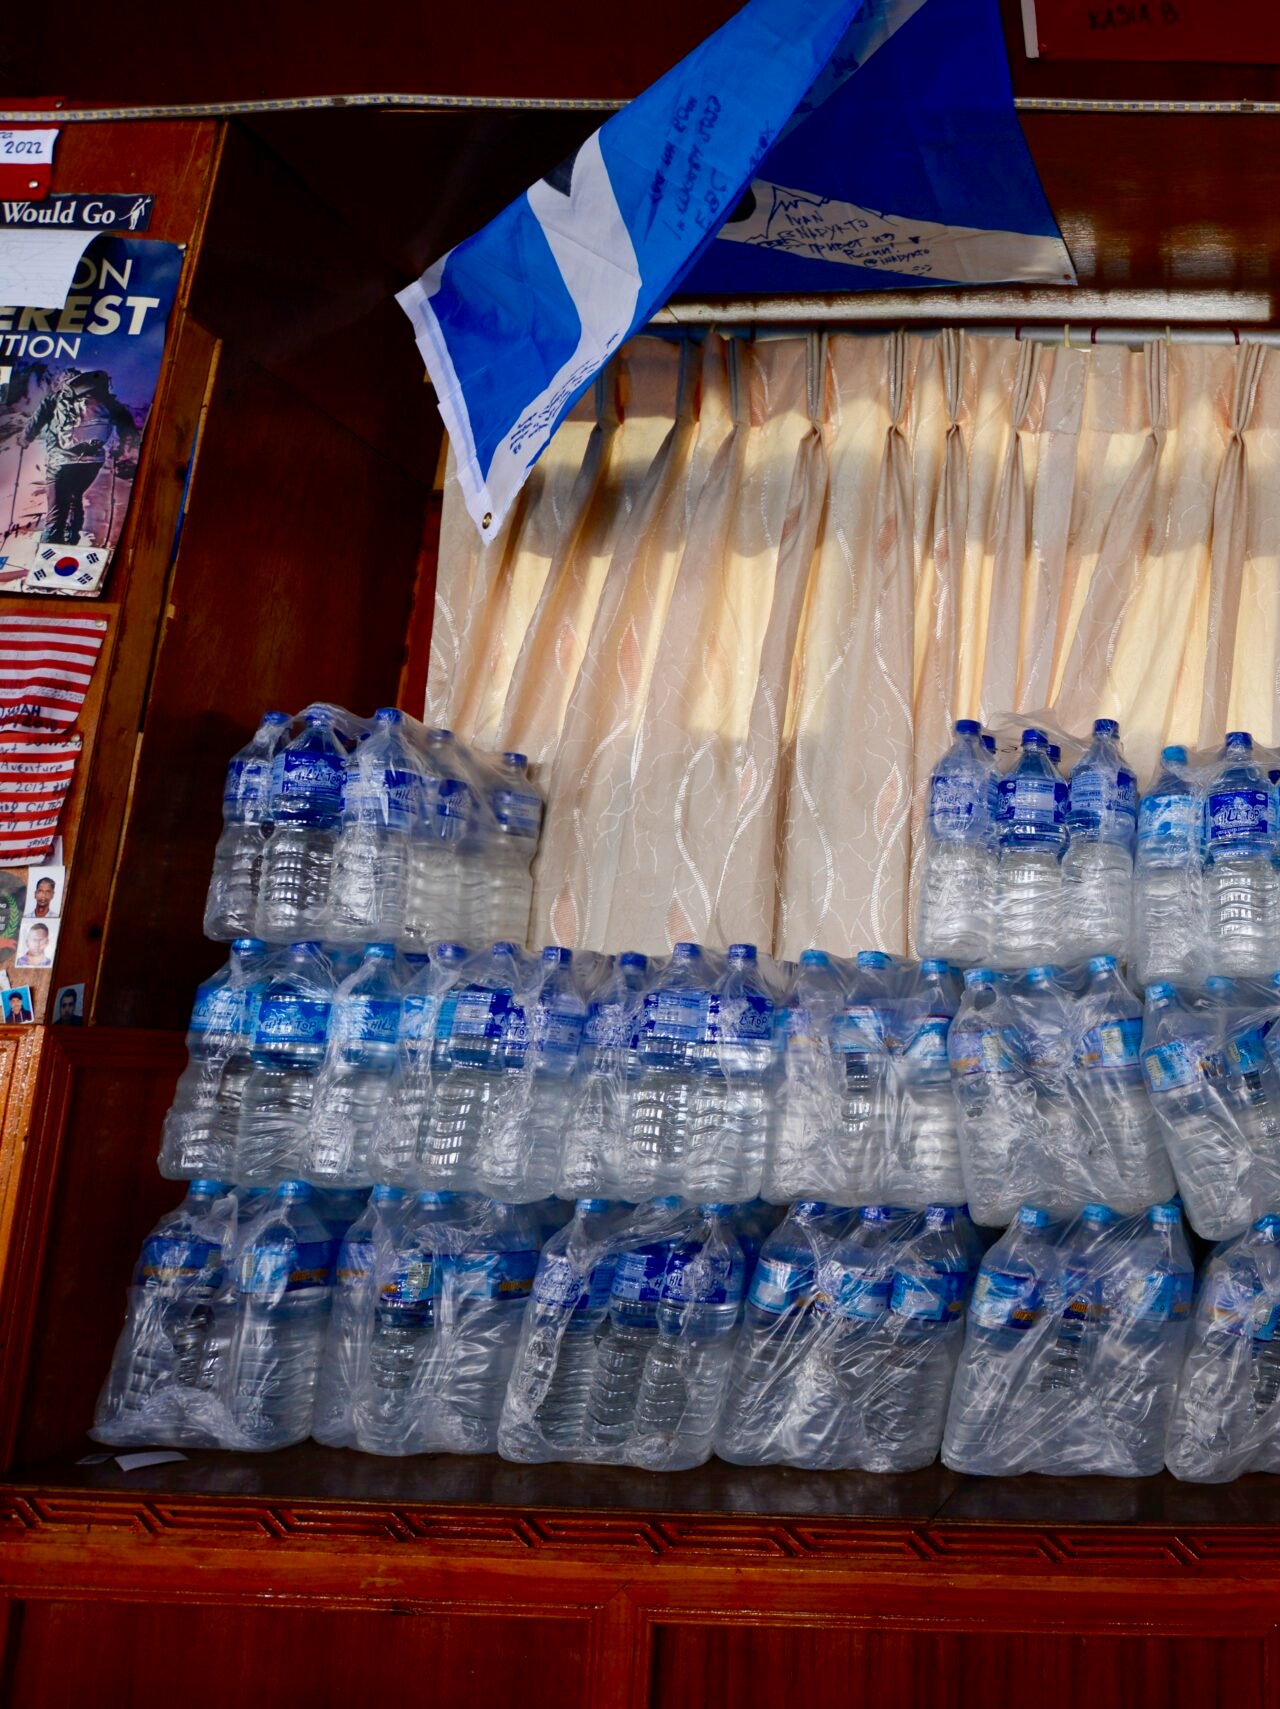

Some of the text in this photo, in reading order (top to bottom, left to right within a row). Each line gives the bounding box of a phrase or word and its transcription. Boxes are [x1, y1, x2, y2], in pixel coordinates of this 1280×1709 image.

[4, 140, 43, 154] 2022
[2, 201, 116, 224] Would Go
[785, 210, 824, 226] IVAN
[0, 334, 81, 360] TION
[295, 1020, 317, 1033] TOP
